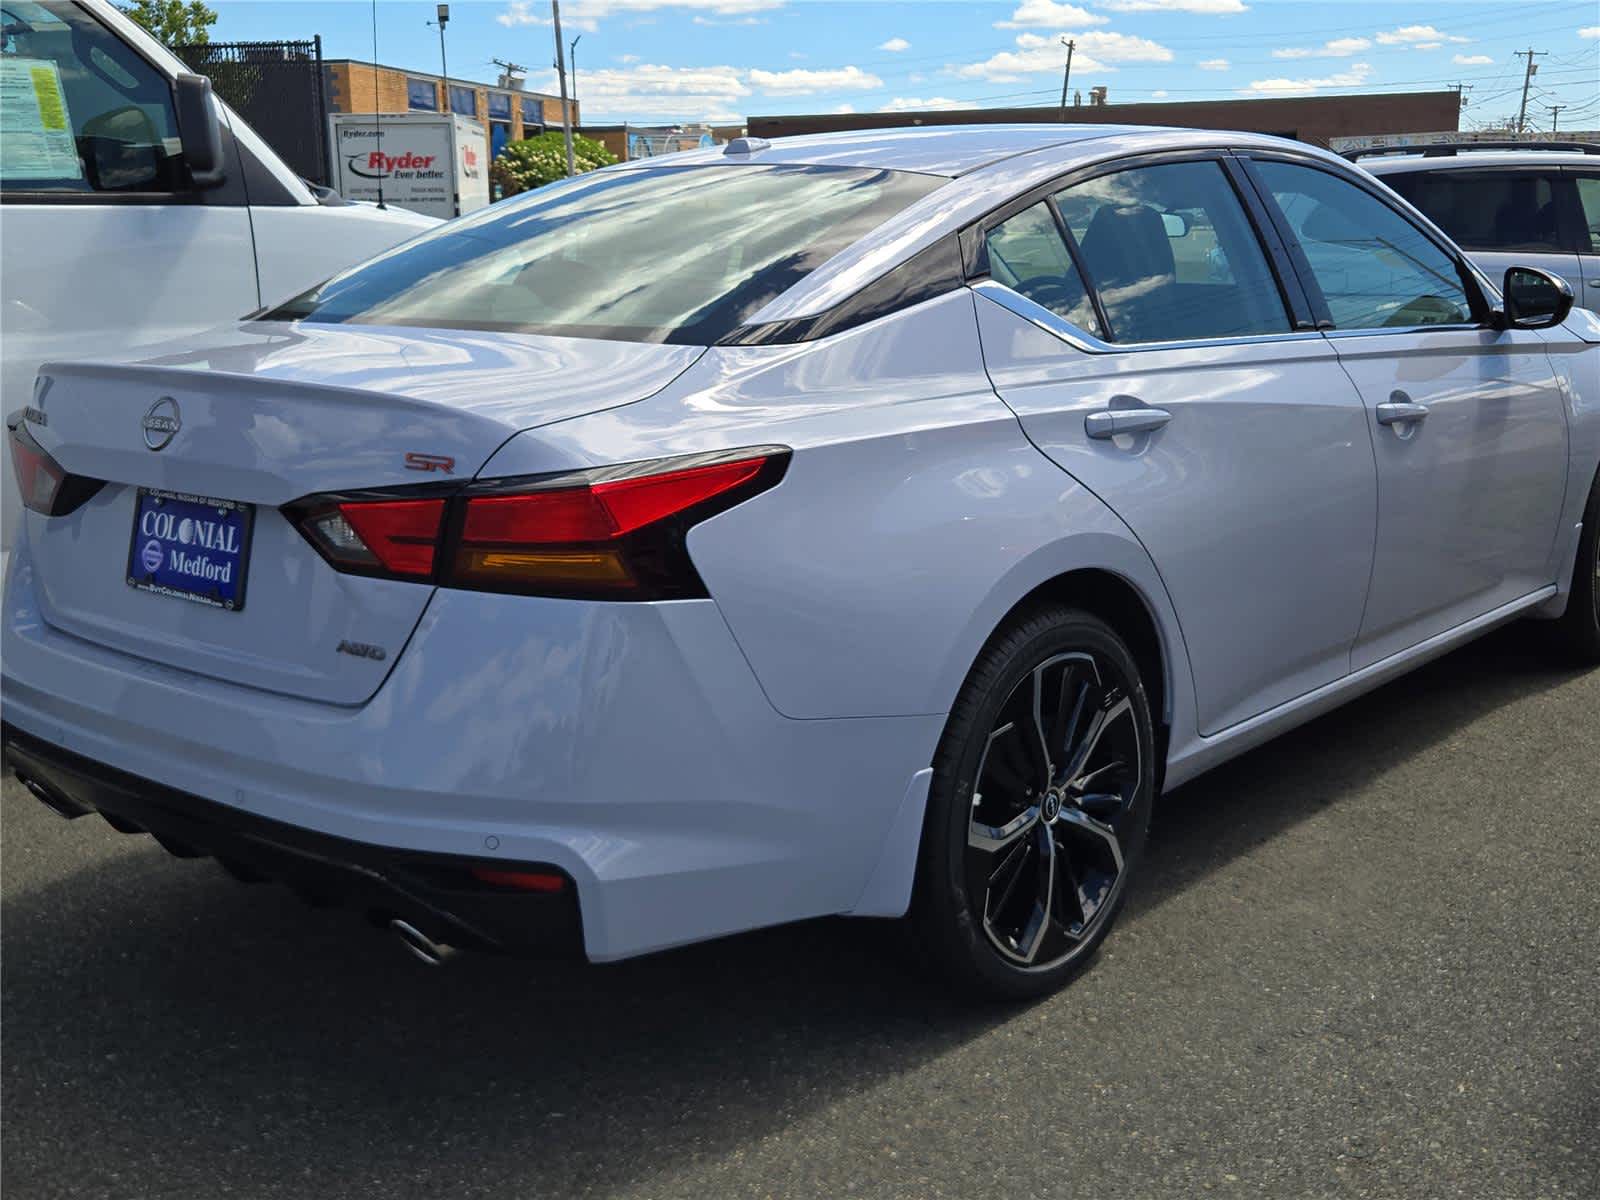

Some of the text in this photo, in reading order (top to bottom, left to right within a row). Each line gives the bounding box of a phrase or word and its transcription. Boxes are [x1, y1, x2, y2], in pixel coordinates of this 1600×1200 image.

[367, 151, 437, 172] Ryder
[394, 169, 444, 180] Ever better
[405, 452, 455, 475] SR
[142, 510, 240, 553] COLONIAL
[169, 549, 232, 583] Medford
